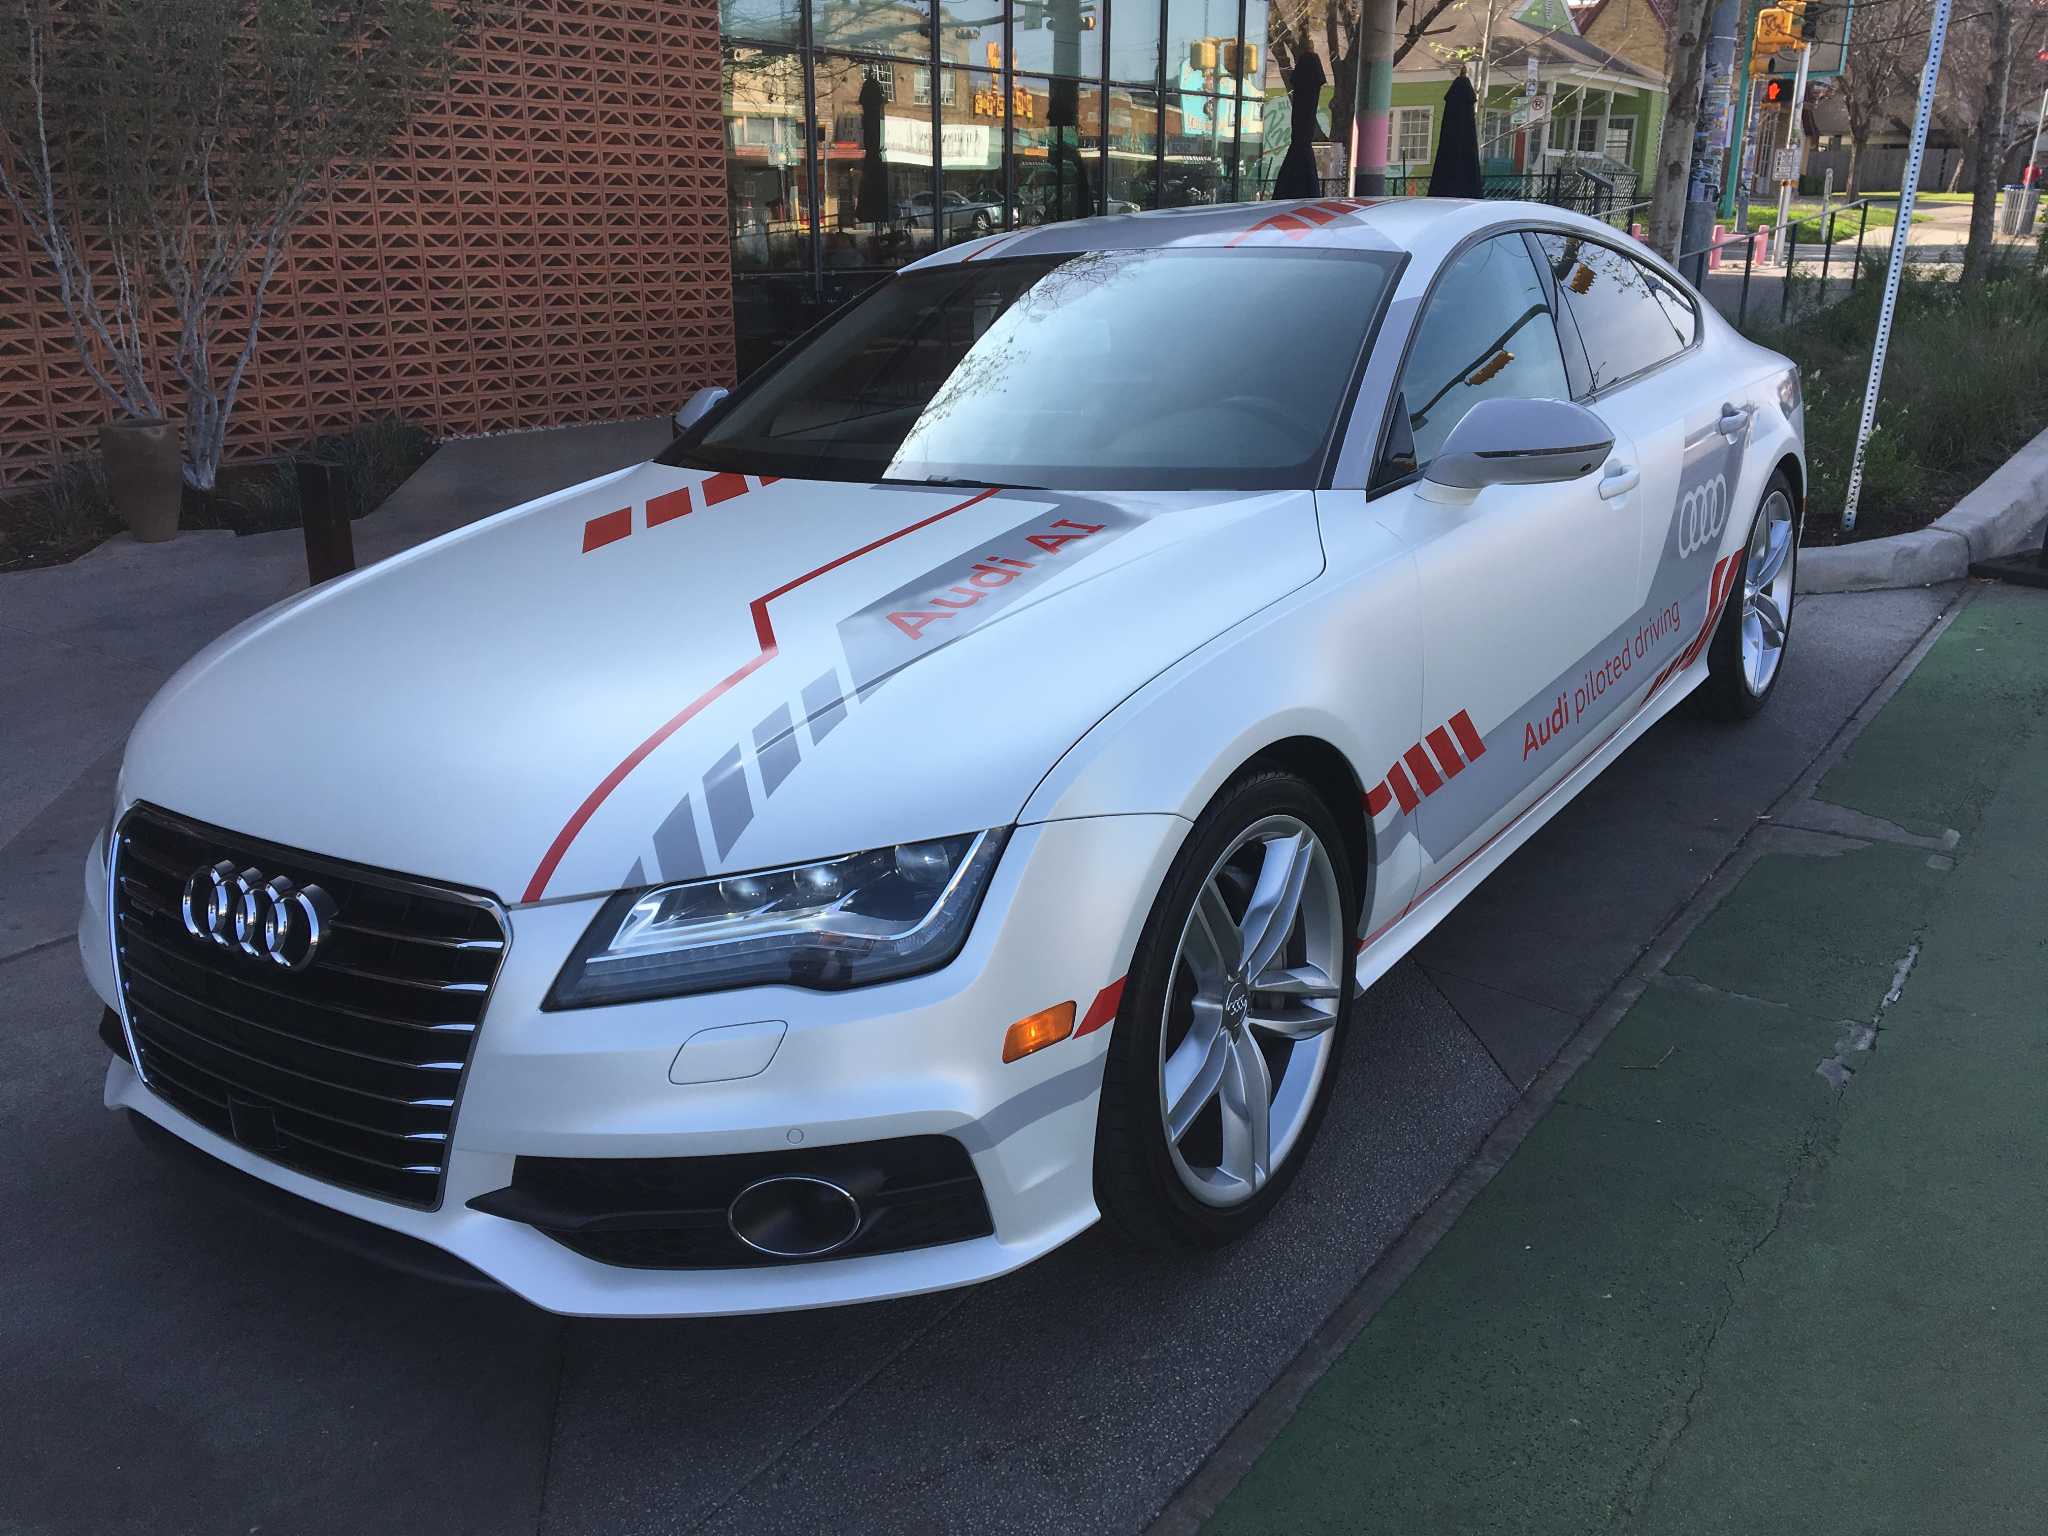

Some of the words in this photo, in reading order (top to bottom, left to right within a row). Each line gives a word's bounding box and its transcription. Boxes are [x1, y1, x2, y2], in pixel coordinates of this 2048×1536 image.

[886, 556, 1037, 640] Audi
[1026, 519, 1106, 554] AI
[1522, 688, 1570, 762] Audi
[1575, 638, 1632, 723] piloted
[1634, 600, 1681, 659] driving
